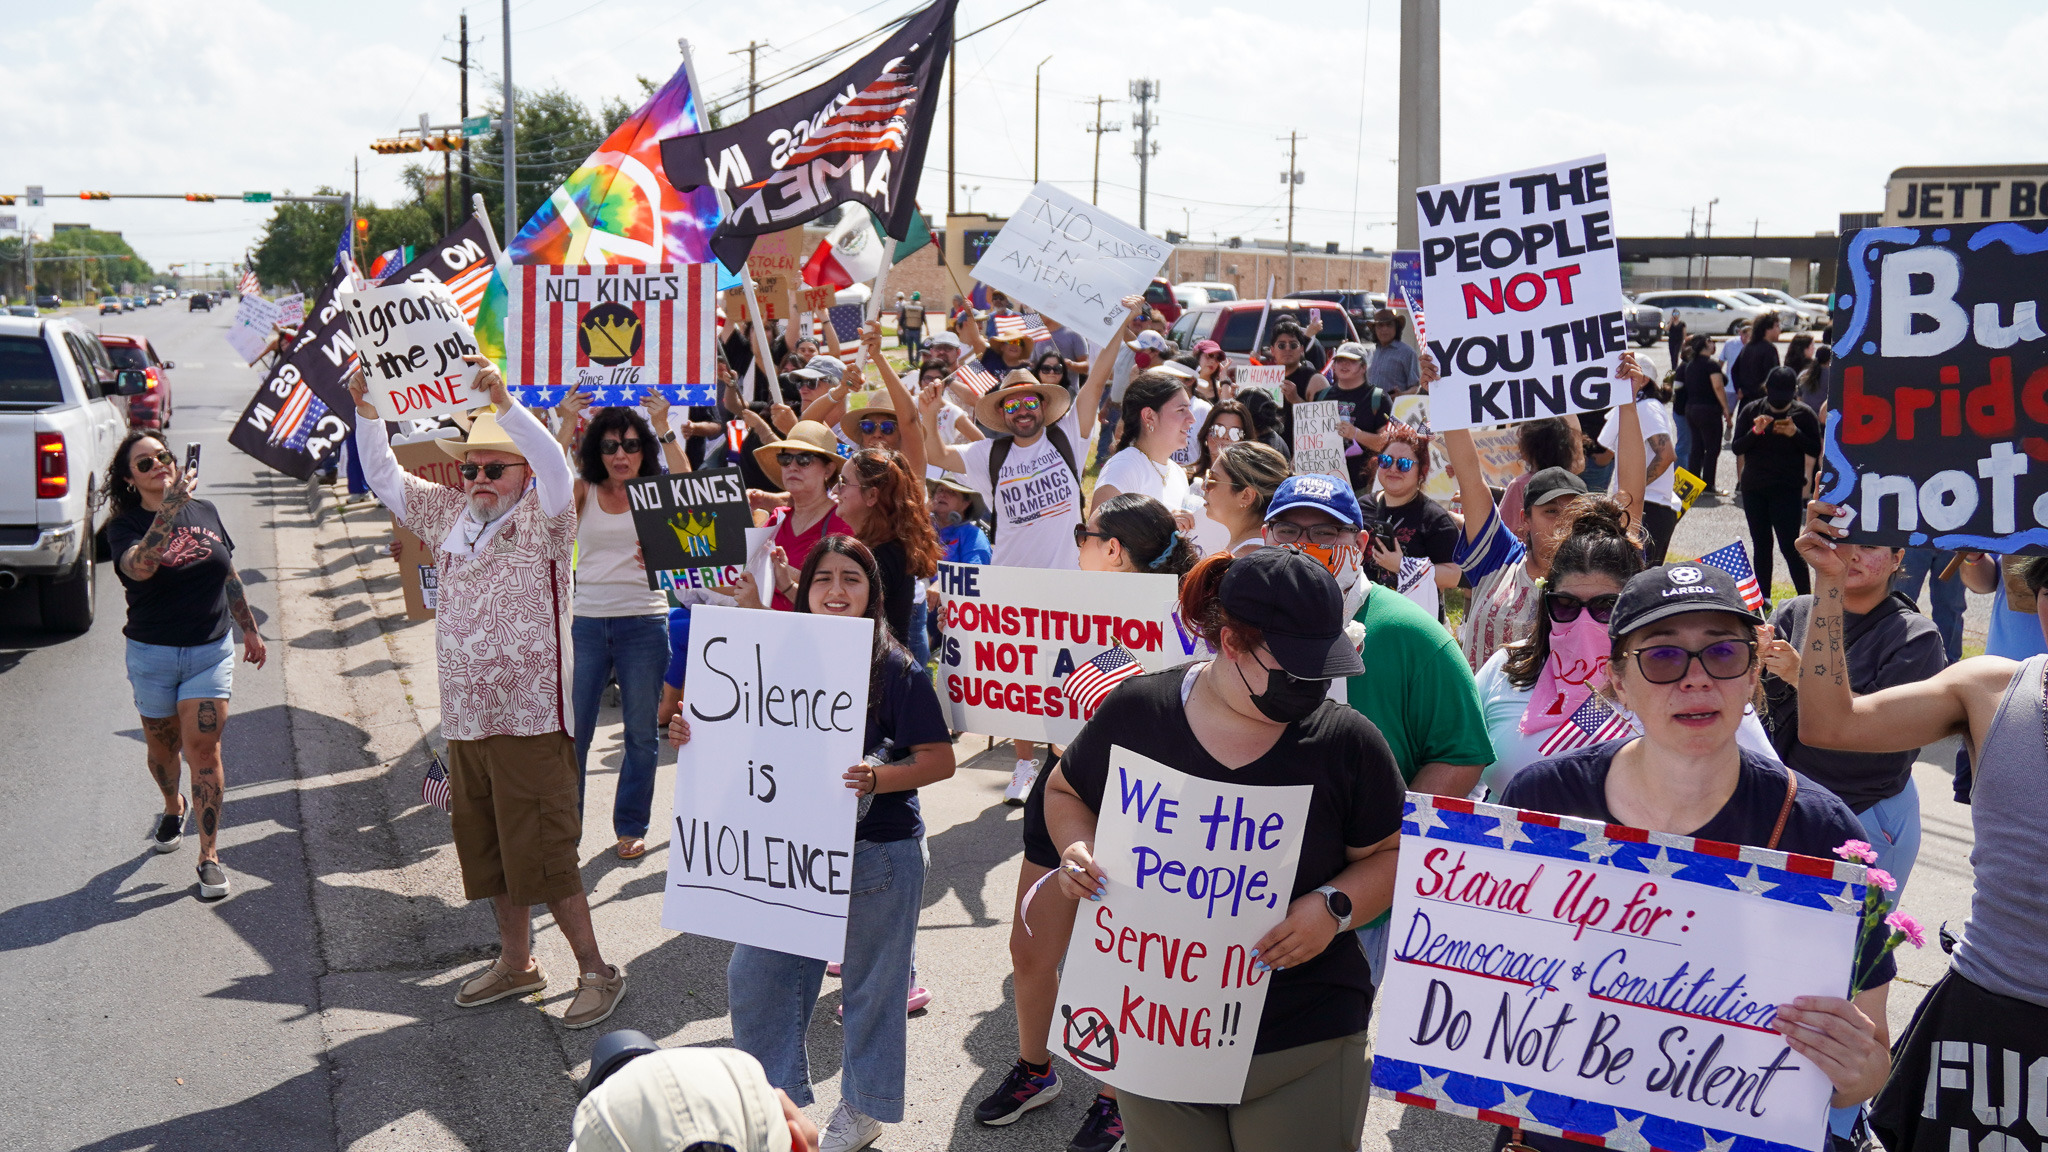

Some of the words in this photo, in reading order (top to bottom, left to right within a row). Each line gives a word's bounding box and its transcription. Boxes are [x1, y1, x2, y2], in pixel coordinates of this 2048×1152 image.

[1417, 181, 1501, 227] WE
[1510, 162, 1610, 215] THE
[1898, 182, 2000, 219] JETT
[1033, 198, 1092, 242] NO
[1098, 239, 1161, 259] KINGS
[1423, 211, 1614, 277] PEOPLE
[748, 255, 795, 270] STOLEN
[1039, 239, 1080, 265] IN
[546, 278, 579, 302] NO
[597, 275, 679, 302] KINGS
[1001, 250, 1105, 309] AMERICA
[1461, 263, 1582, 320] NOT
[741, 303, 775, 319] IE
[375, 344, 429, 379] the
[433, 331, 477, 378] job
[1427, 330, 1535, 378] YOU
[1541, 311, 1628, 367] THE
[388, 374, 469, 416] DONE
[577, 369, 604, 385] Since
[610, 366, 641, 385] 1776
[1238, 369, 1248, 382] NO
[1250, 368, 1285, 383] HUMAN
[1469, 366, 1611, 424] KING
[1295, 402, 1338, 420] AMERICA
[1296, 419, 1318, 435] HAS
[1322, 417, 1337, 433] NO
[1295, 434, 1324, 451] KING
[1296, 448, 1342, 461] AMERICA
[1000, 486, 1021, 505] NO
[1024, 468, 1069, 498] KINGS
[1296, 460, 1325, 472] NEEDS
[1328, 459, 1341, 470] NO
[628, 481, 663, 511] NO
[670, 474, 743, 507] KINGS
[1005, 504, 1016, 519] IN
[1020, 485, 1072, 515] AMERICA
[1293, 485, 1331, 499] PIZZA
[1861, 441, 2028, 535] not
[687, 535, 711, 557] IN
[659, 564, 746, 591] AMERIC
[937, 563, 980, 597] THE
[1661, 585, 1715, 597] LAREDO
[947, 600, 1163, 652] CONSTITUTION
[941, 634, 961, 667] IS
[975, 641, 1038, 675] NOT
[1053, 648, 1076, 678] A
[690, 636, 854, 732] Silence
[948, 674, 1095, 722] SUGGEST
[748, 760, 777, 803] is
[1200, 796, 1284, 851] the
[676, 815, 850, 895] VIOLENCE
[1132, 846, 1278, 918] People,
[1416, 847, 1545, 915] Stand
[1553, 869, 1610, 941] Up
[1095, 905, 1207, 983] Serve
[1221, 943, 1265, 989] no
[1394, 907, 1566, 999] Democracy
[1588, 948, 1779, 1031] Constitution
[1119, 985, 1241, 1049] KING!!
[1410, 978, 1472, 1051] Do
[1483, 990, 1577, 1073] Not
[1577, 1010, 1636, 1086] Be
[1646, 1025, 1800, 1118] Silent
